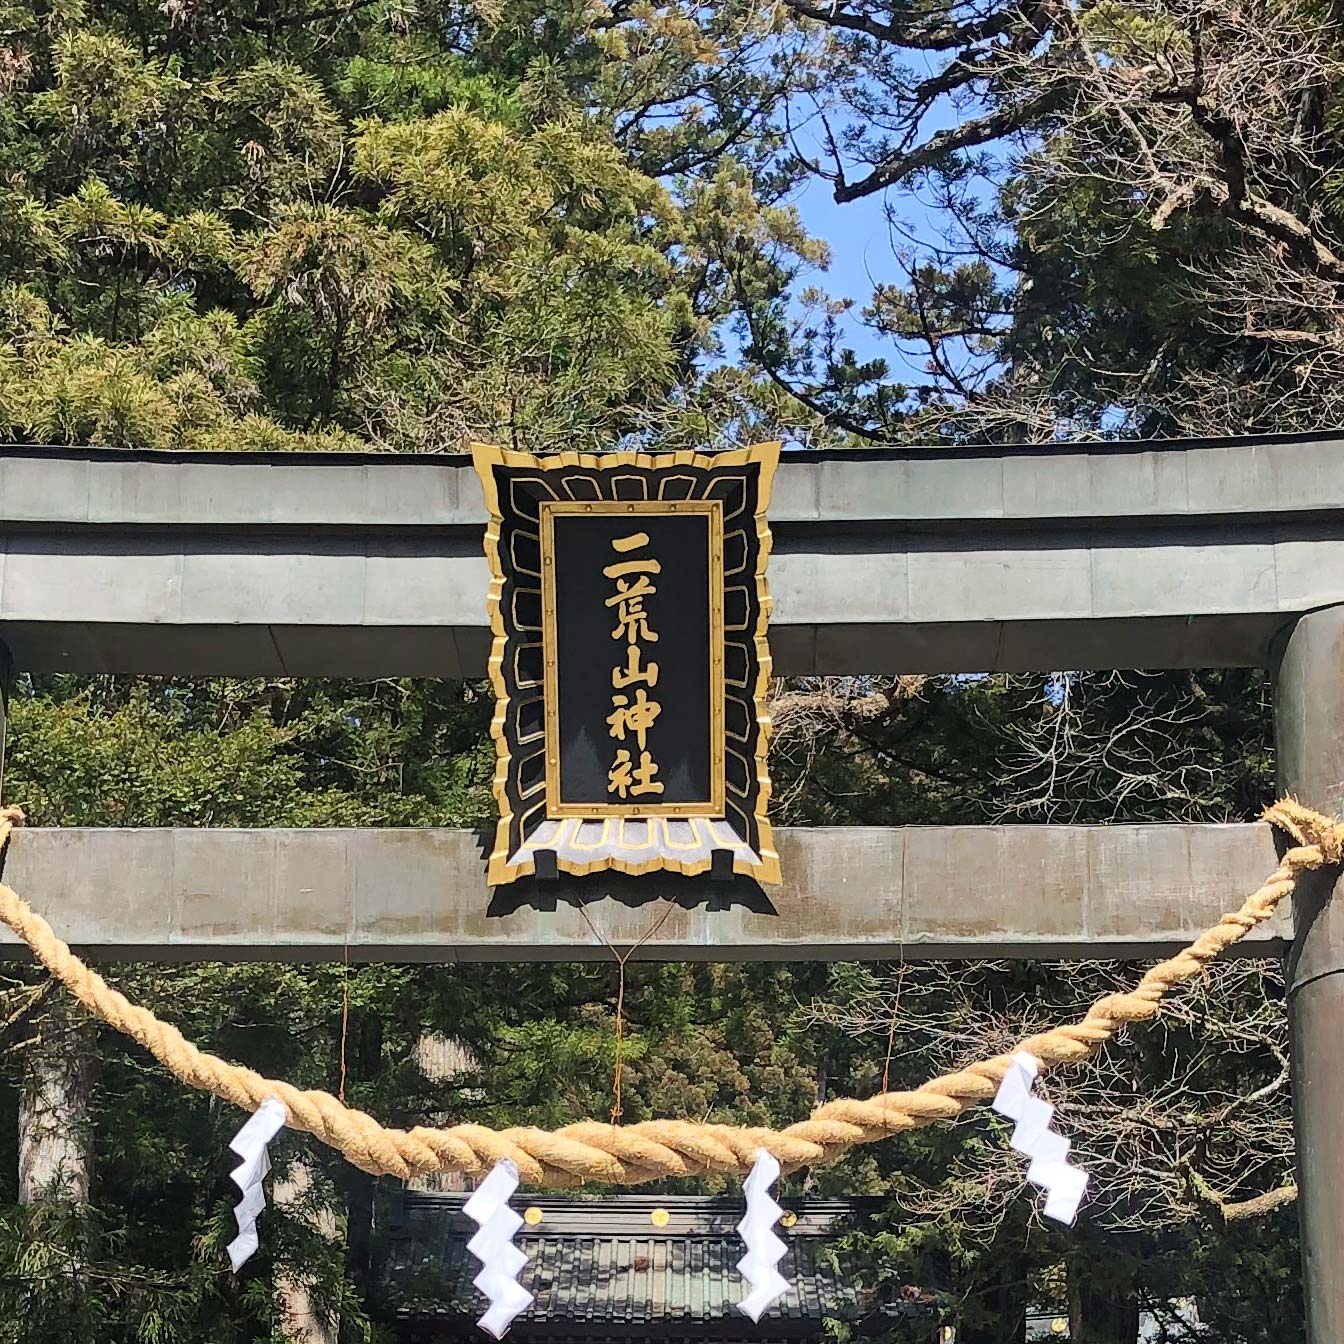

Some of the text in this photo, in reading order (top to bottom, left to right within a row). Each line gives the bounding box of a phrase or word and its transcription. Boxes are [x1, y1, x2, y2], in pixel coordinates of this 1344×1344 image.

[602, 531, 665, 799] 二荒山神社
